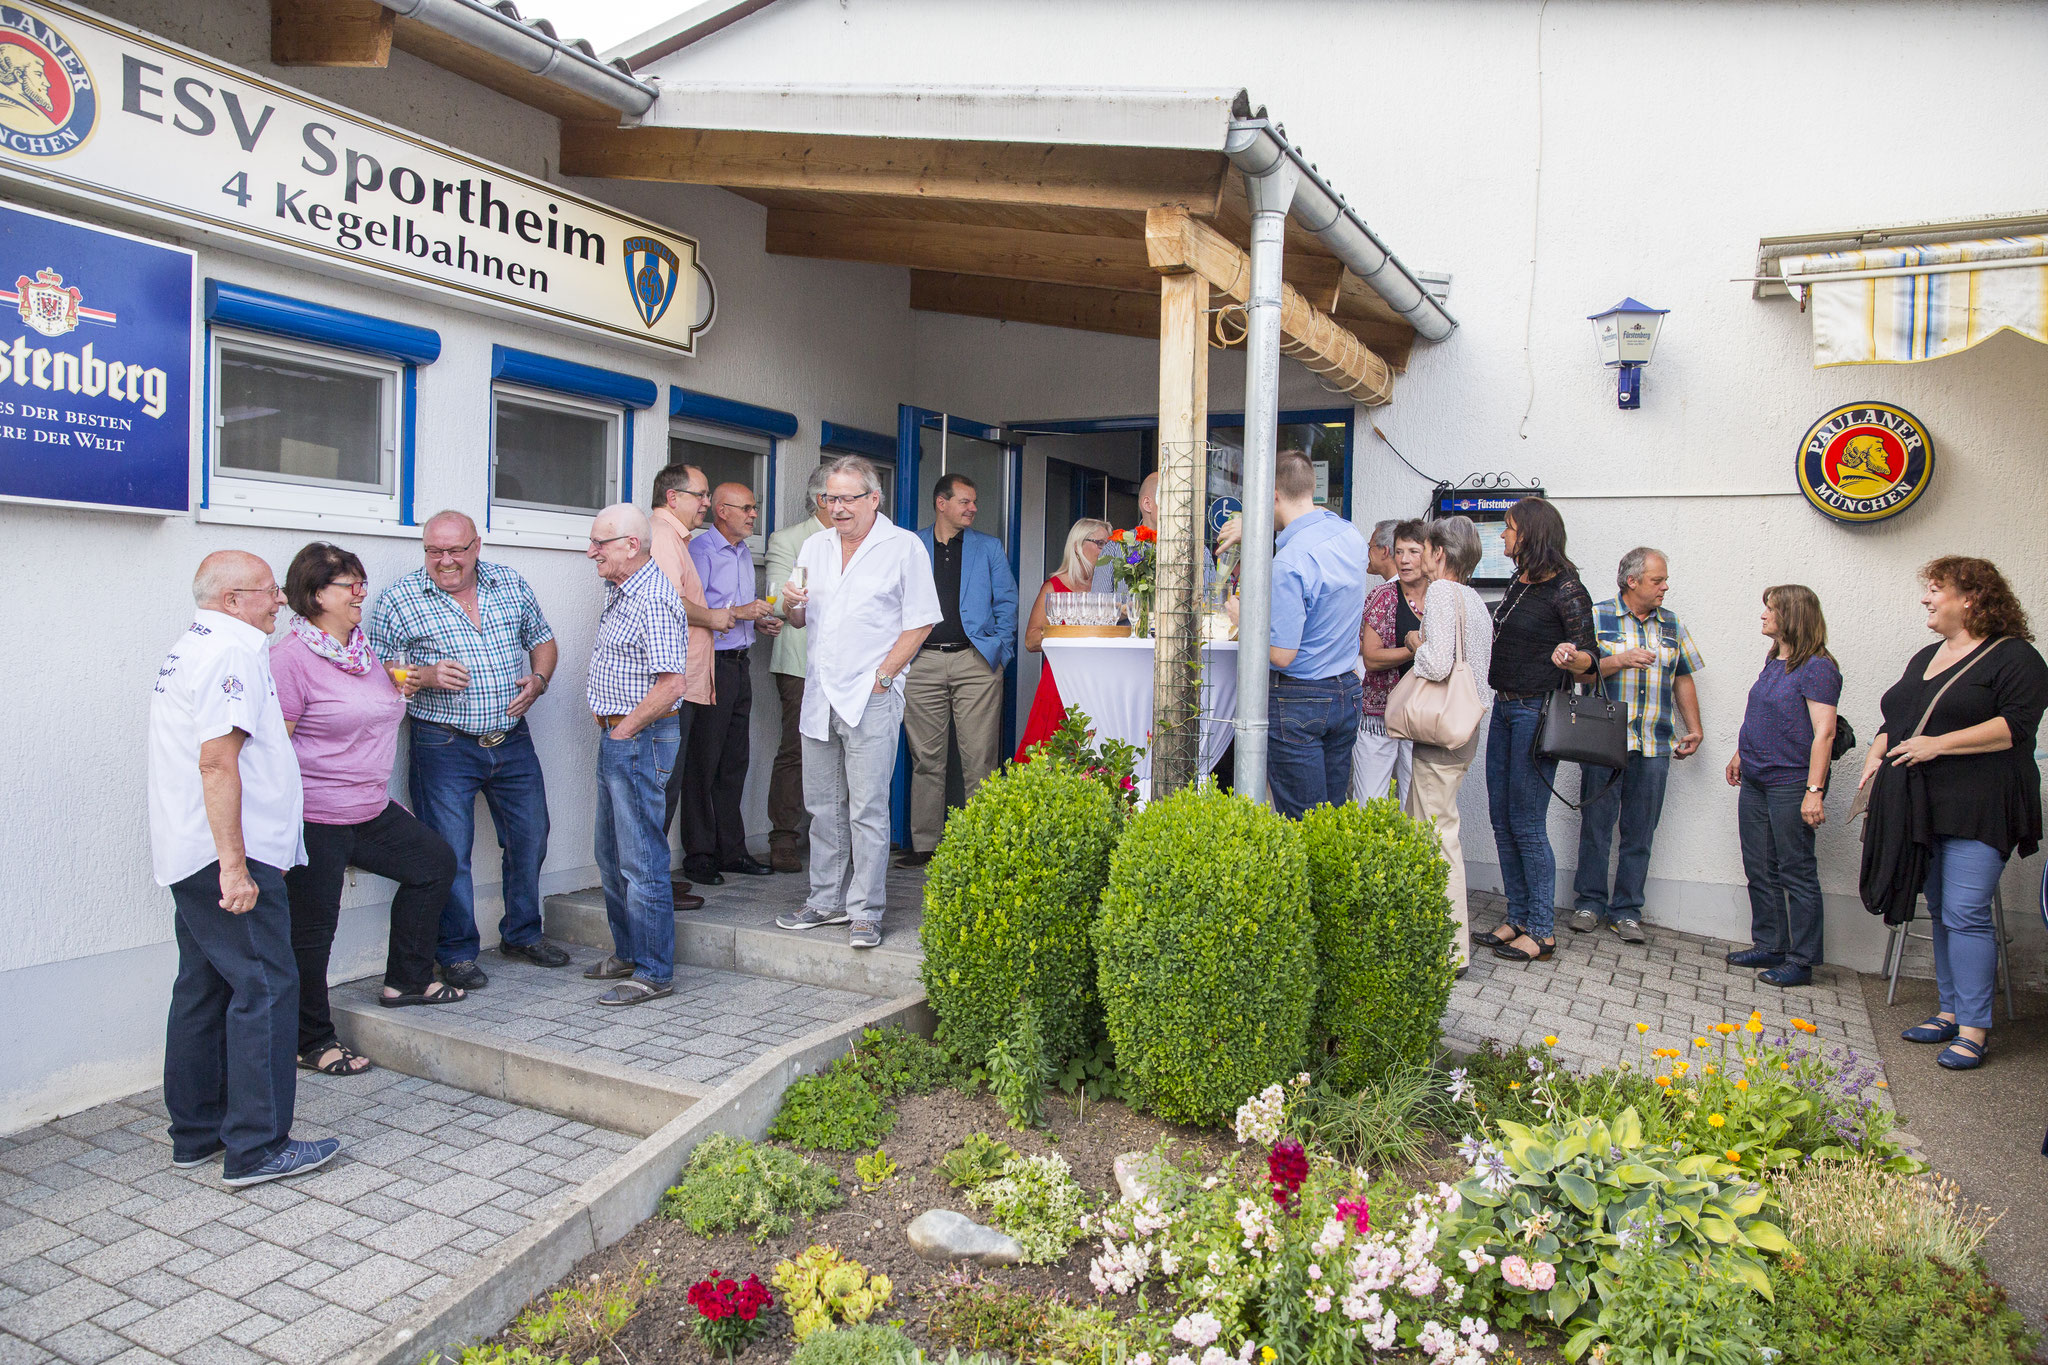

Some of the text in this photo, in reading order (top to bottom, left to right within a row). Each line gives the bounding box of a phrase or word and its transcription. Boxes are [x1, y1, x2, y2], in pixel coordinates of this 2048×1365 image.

[121, 53, 606, 265] ESV Sportheim
[222, 171, 548, 293] 4 Kegelbahnen
[625, 238, 676, 266] ROTTWEIL
[21, 404, 59, 421] DER
[65, 410, 133, 431] BESTEN
[1807, 409, 1923, 455] PAULANER
[33, 429, 71, 446] DER
[1814, 480, 1914, 513] MÜNCHEN
